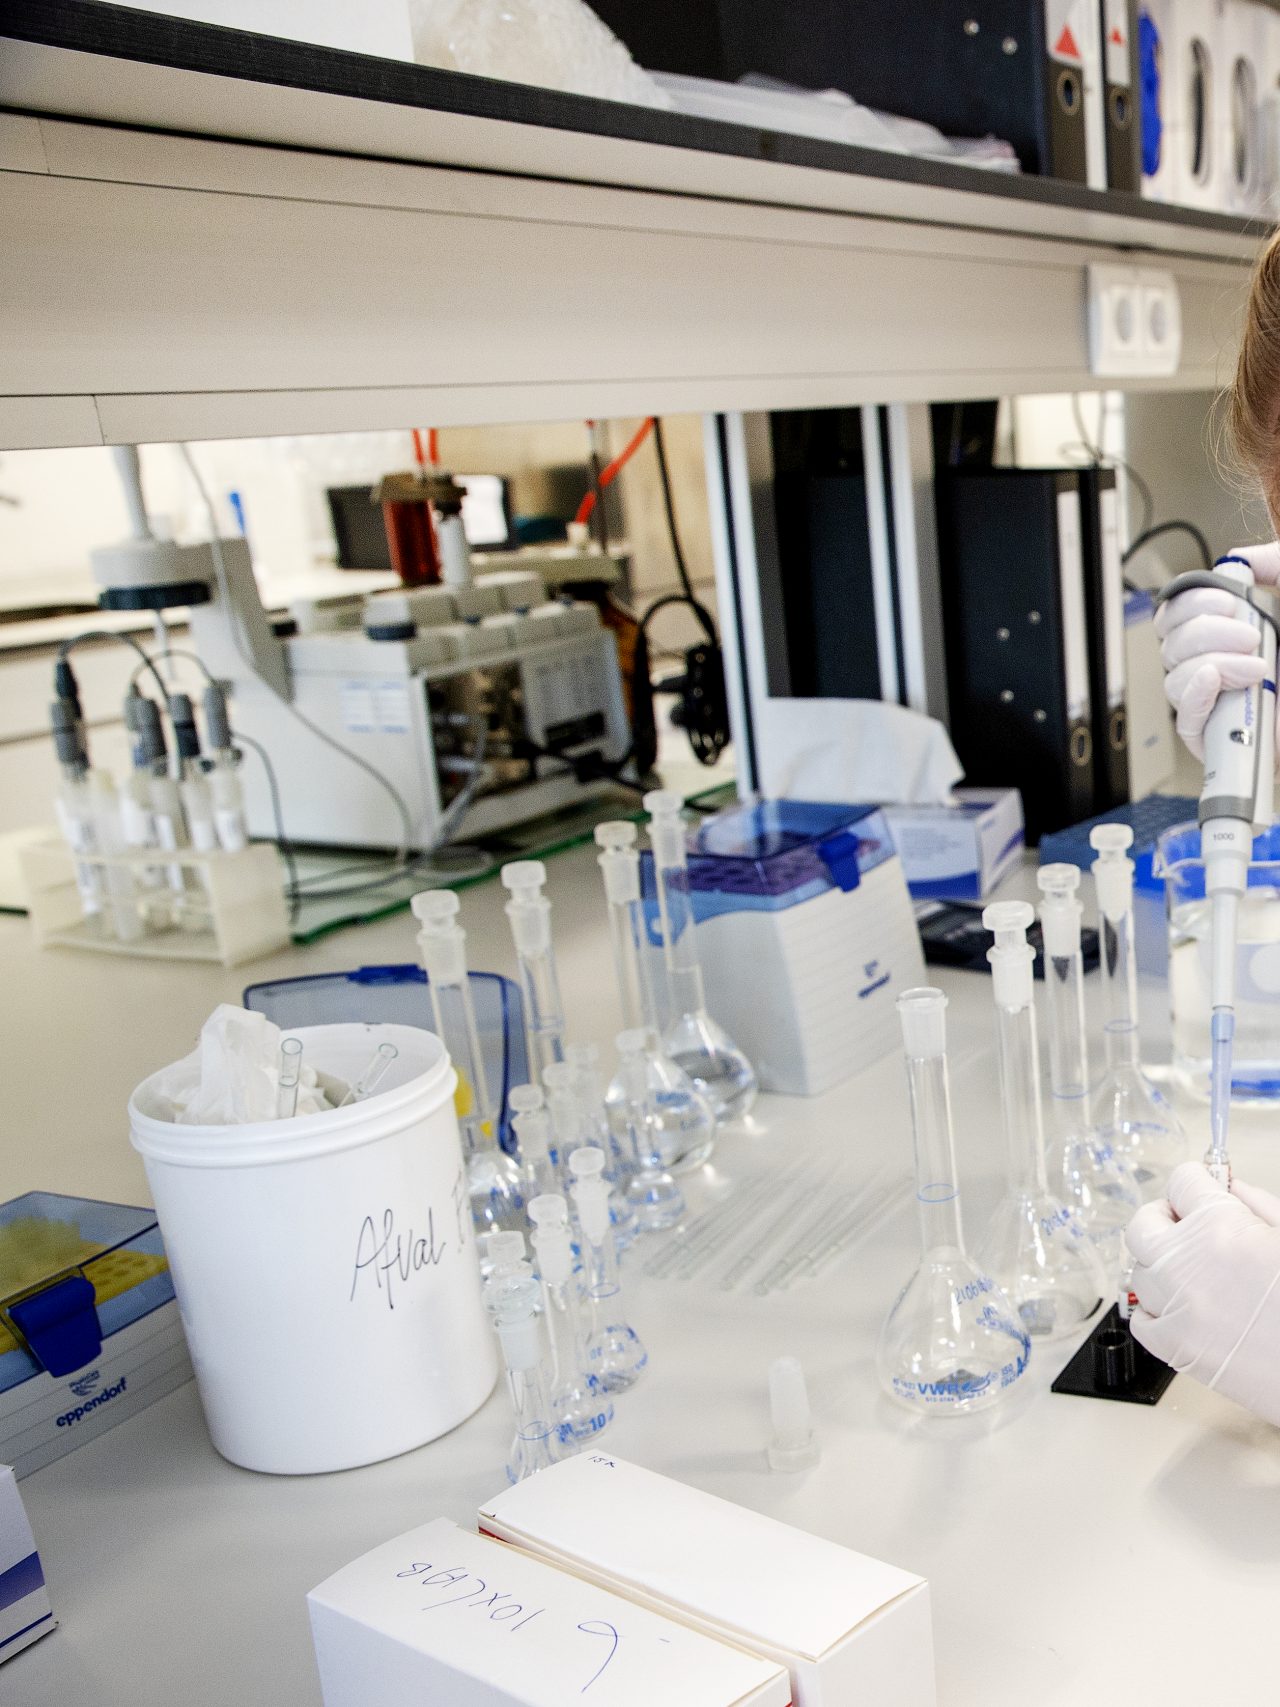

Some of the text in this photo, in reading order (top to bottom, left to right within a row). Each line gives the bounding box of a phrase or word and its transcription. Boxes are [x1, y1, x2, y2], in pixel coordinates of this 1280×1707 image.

[1212, 832, 1235, 842] 1000
[350, 1206, 447, 1310] Afval
[56, 1376, 127, 1428] eppendorf
